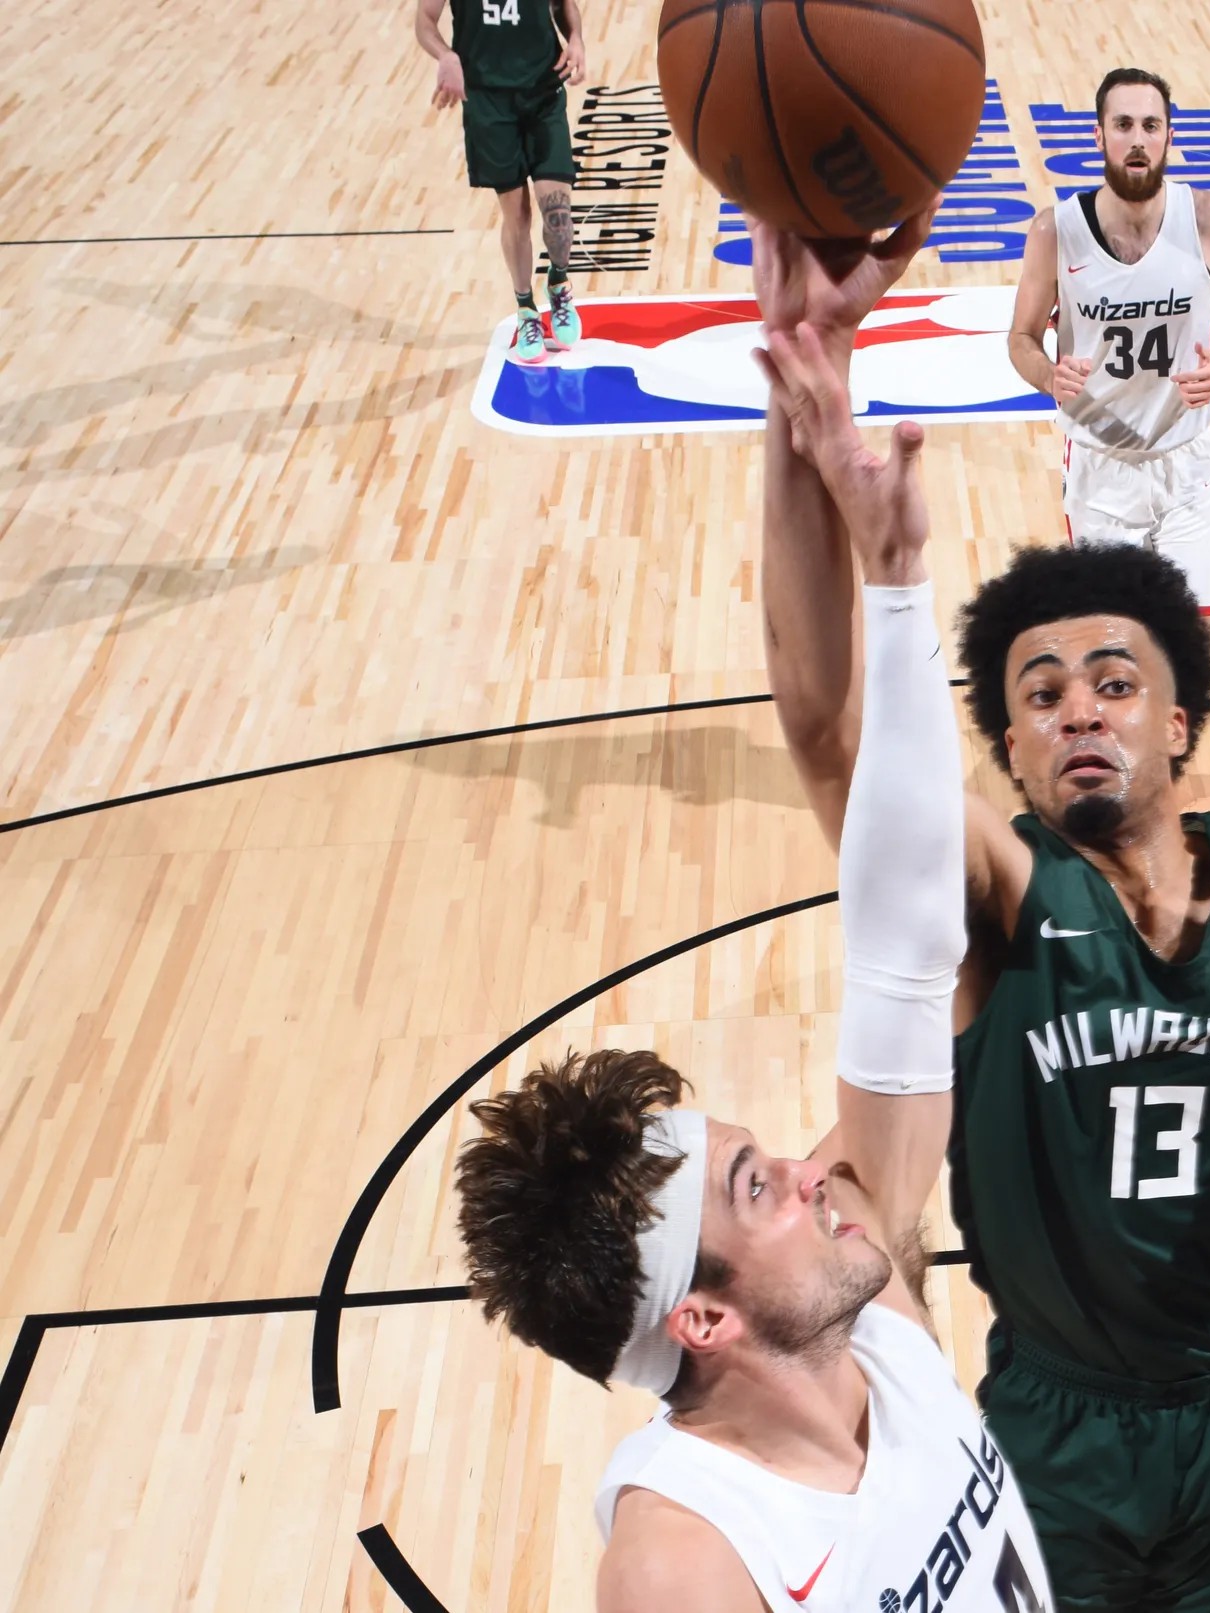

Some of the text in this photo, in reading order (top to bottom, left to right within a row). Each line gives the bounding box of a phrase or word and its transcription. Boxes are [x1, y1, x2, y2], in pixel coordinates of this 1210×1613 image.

[482, 0, 521, 25] 54
[1076, 287, 1194, 322] wizards
[1102, 323, 1174, 380] 34
[1108, 1085, 1208, 1200] 13
